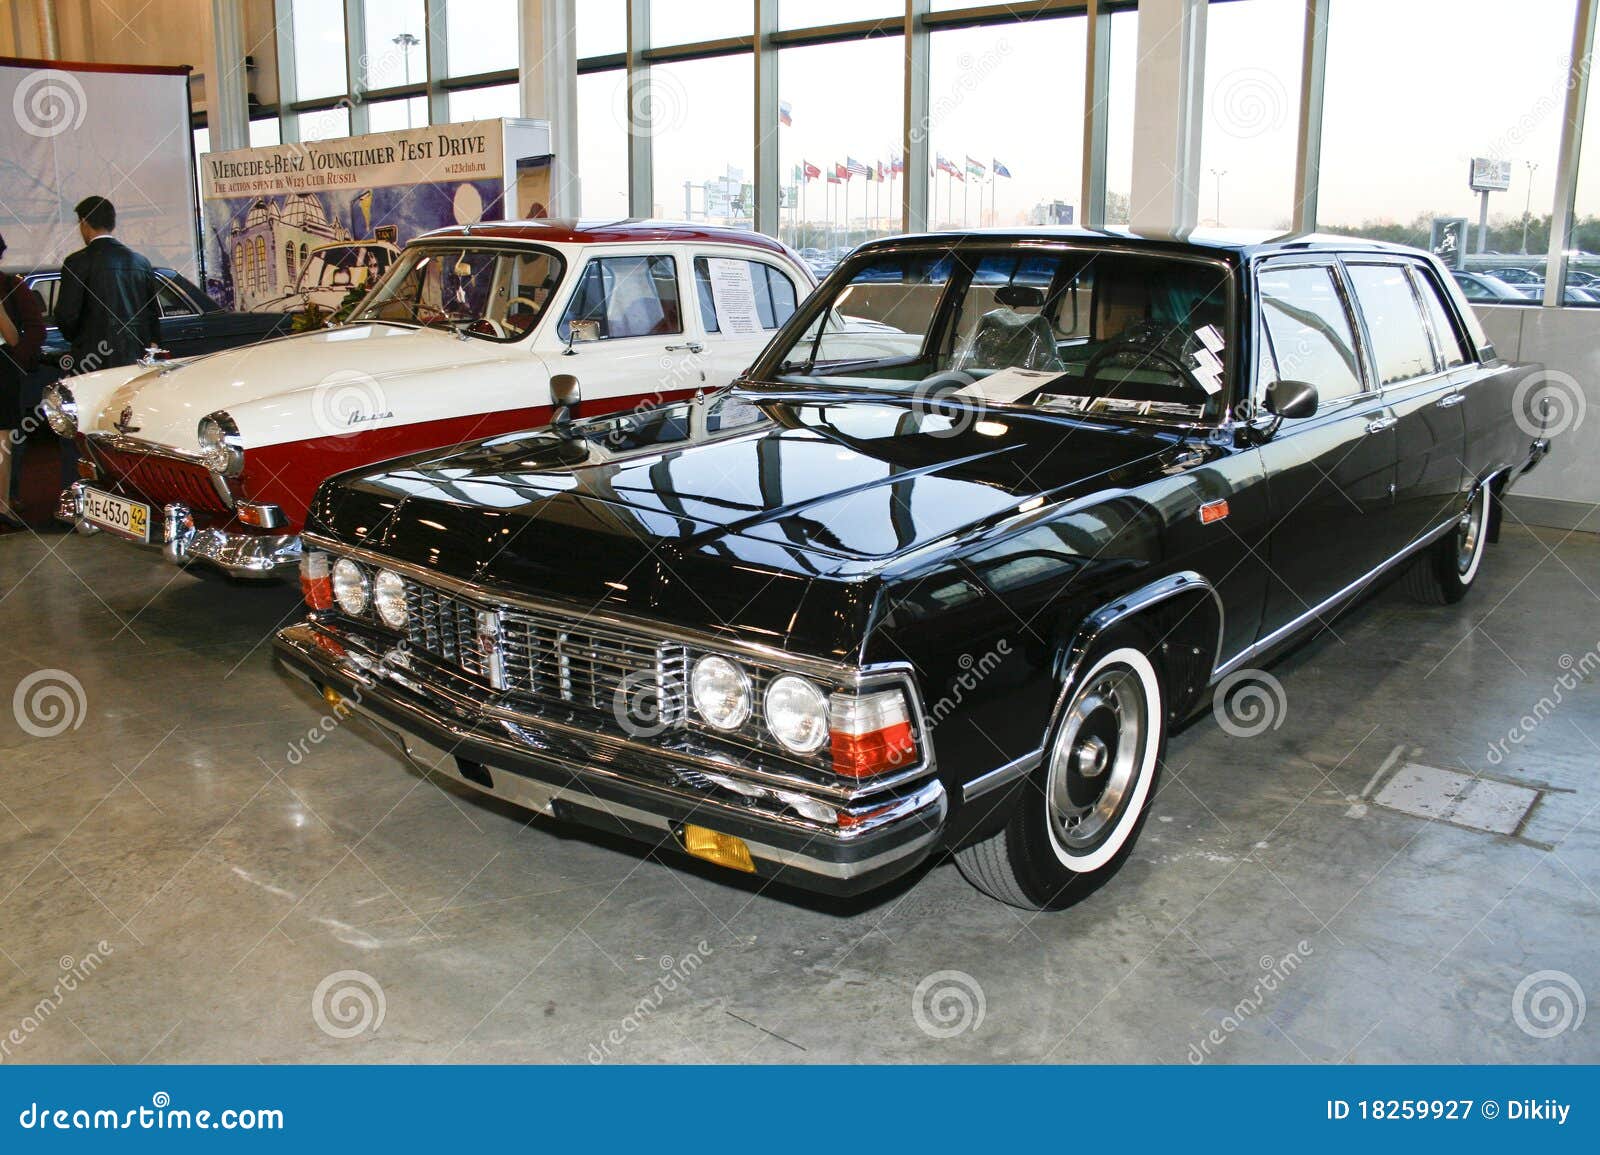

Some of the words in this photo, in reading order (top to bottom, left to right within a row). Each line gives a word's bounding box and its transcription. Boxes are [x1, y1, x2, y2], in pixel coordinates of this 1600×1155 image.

[309, 147, 395, 170] YOUNGTIMER
[399, 140, 433, 161] TEST
[438, 135, 485, 158] DRIVE
